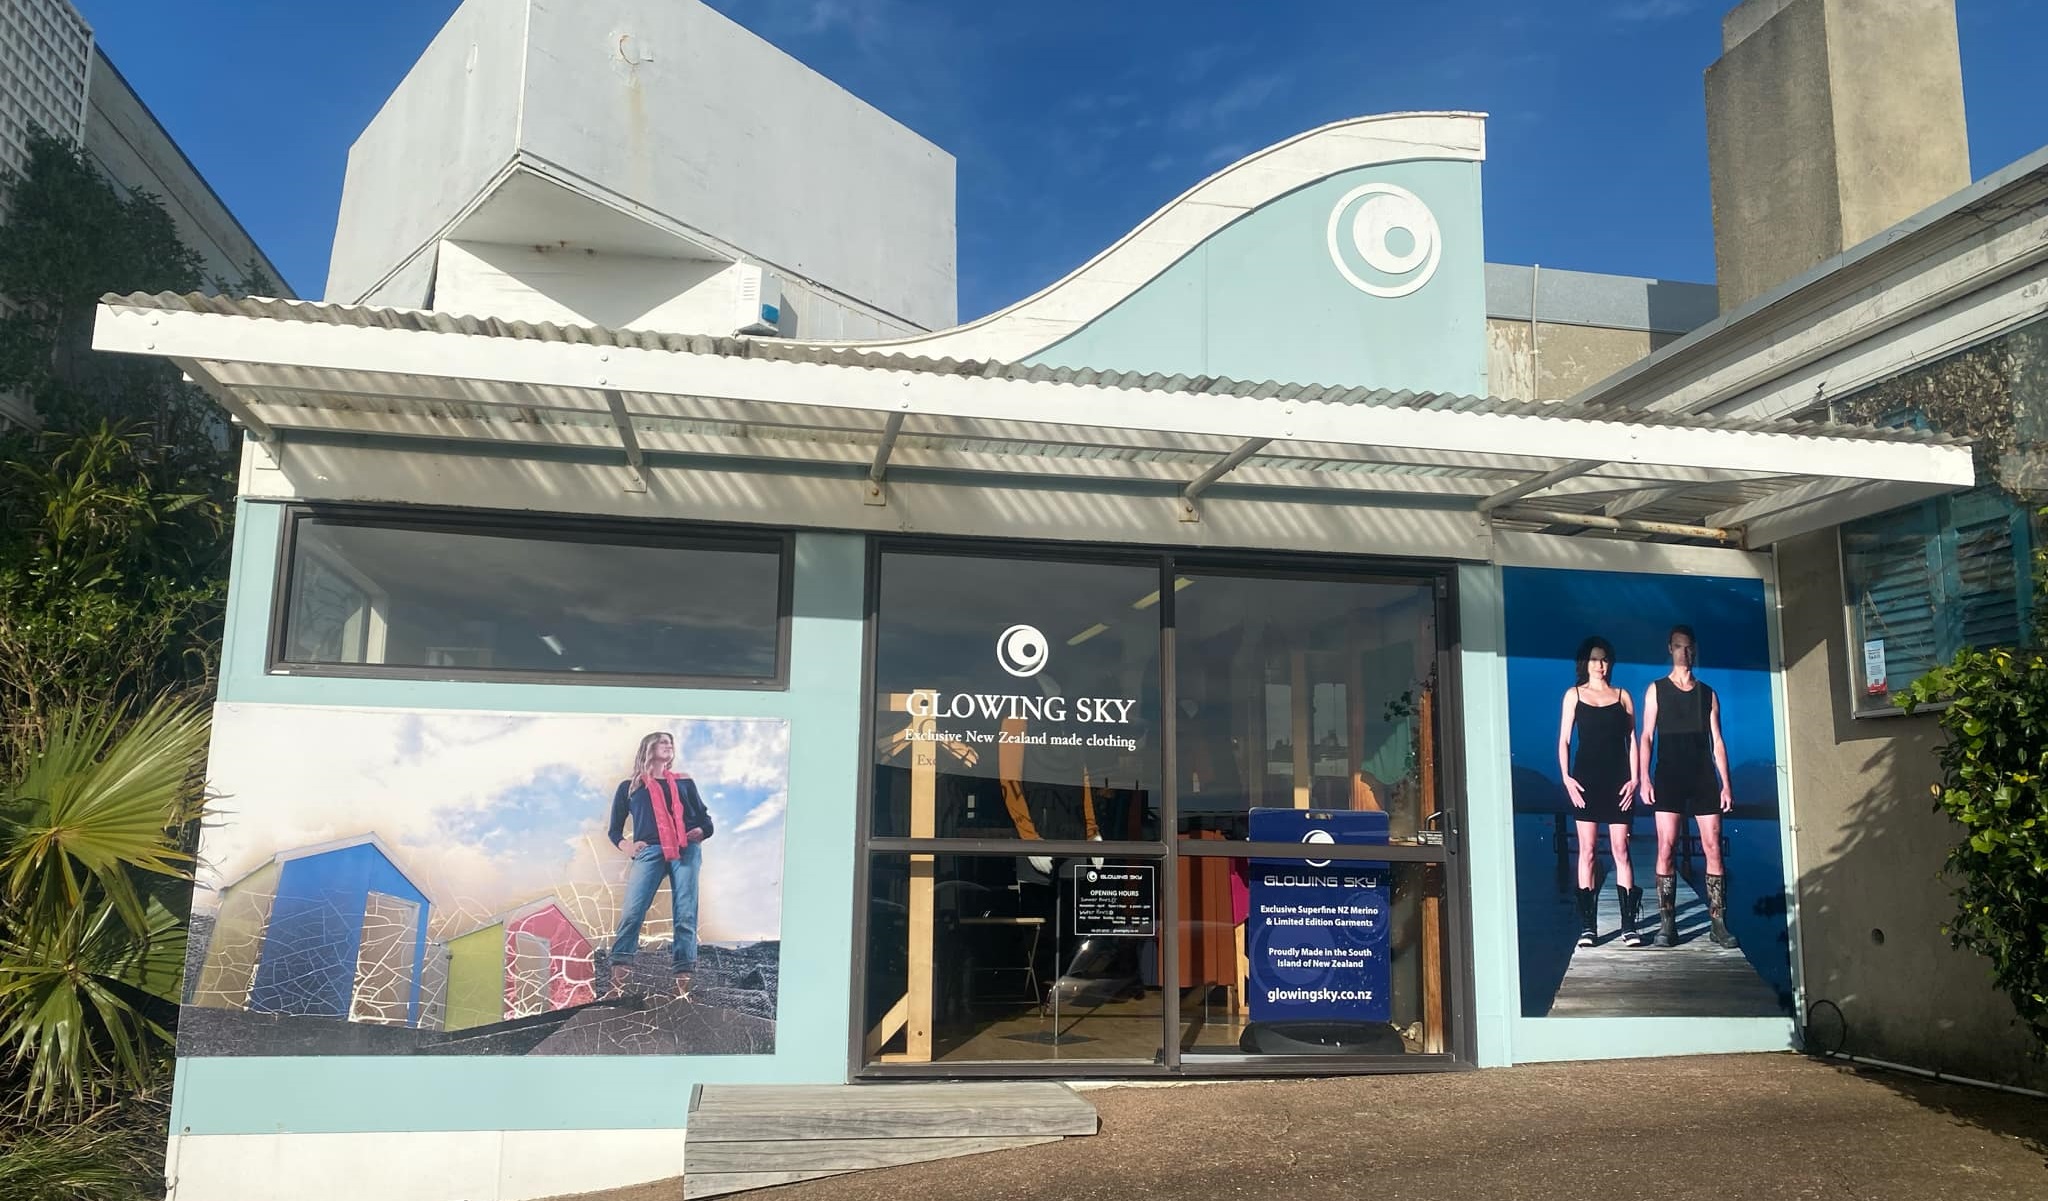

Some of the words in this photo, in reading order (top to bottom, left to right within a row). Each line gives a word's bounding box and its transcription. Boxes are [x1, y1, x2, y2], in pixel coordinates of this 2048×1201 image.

[906, 692, 1067, 722] GLOWING
[1076, 698, 1137, 724] SKY
[904, 728, 962, 742] Exclusive
[966, 730, 995, 743] New
[998, 731, 1047, 745] Zealand
[1050, 732, 1083, 746] made
[1086, 733, 1137, 751] clothing
[1264, 876, 1338, 887] GLOWING
[1344, 877, 1377, 888] SKY
[1260, 905, 1297, 913] Exclusive
[1298, 905, 1337, 915] Superfine
[1338, 906, 1349, 914] NZ
[1350, 906, 1379, 915] Merino
[1266, 918, 1273, 926] &
[1274, 918, 1304, 926] Limited
[1305, 918, 1334, 926] Edition
[1335, 919, 1374, 927] Garments
[1268, 948, 1300, 958] Proudly
[1301, 948, 1324, 956] Made
[1325, 948, 1333, 956] in
[1334, 948, 1347, 957] the
[1348, 948, 1373, 957] South
[1277, 959, 1302, 967] Island
[1303, 959, 1312, 967] of
[1312, 960, 1331, 968] New
[1331, 959, 1364, 968] Zealand
[1267, 987, 1373, 1003] glowingsky.co.nz
